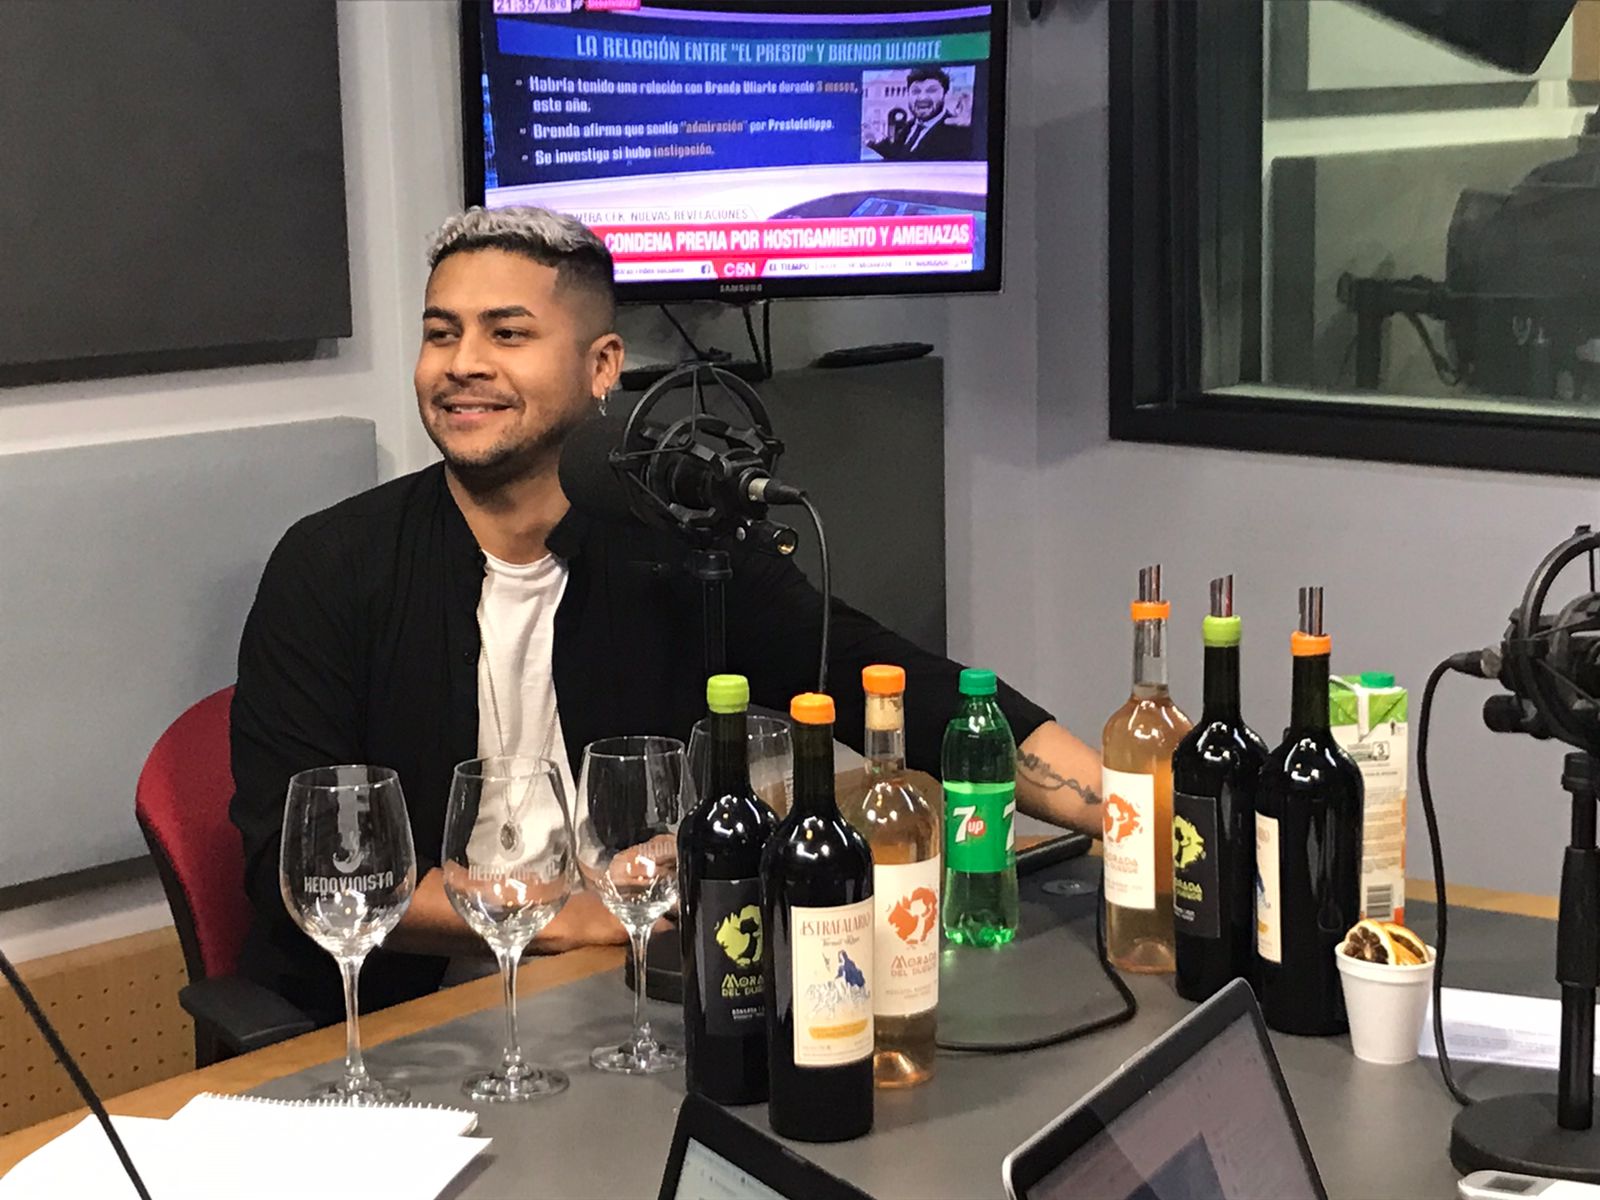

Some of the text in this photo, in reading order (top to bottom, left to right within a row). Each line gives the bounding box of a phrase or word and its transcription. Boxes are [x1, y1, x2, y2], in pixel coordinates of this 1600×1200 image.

[576, 34, 942, 63] LA RELACIÓN ENTRE "EL PRESTO" Y BRENDA ULIARTE
[529, 75, 574, 93] Habría
[578, 78, 614, 94] tenido
[617, 81, 637, 94] una
[640, 79, 682, 94] relación
[685, 82, 703, 94] con
[705, 80, 741, 94] Brenda
[743, 81, 777, 94] Uliarte
[779, 80, 815, 94] durante
[533, 97, 562, 112] este
[533, 123, 580, 139] Brenda
[584, 121, 622, 137] afirma
[625, 123, 644, 137] que
[646, 120, 678, 136] sentía
[750, 121, 766, 134] por
[535, 150, 552, 165] Se
[555, 147, 609, 164] investiga
[613, 146, 622, 160] si
[625, 145, 651, 160] hubo
[576, 211, 601, 223] NTRA
[631, 210, 670, 222] NUEVAS
[674, 207, 748, 220] REVELACIONES
[604, 223, 969, 252] CONDENA PREVIA POR HOSTIGAMIENTO Y AMENAZAS
[723, 262, 756, 276] C5N
[719, 283, 763, 293] SAMSUNG
[304, 871, 394, 896] HEDOVINISTA
[800, 911, 871, 936] ESTRAFALARIO
